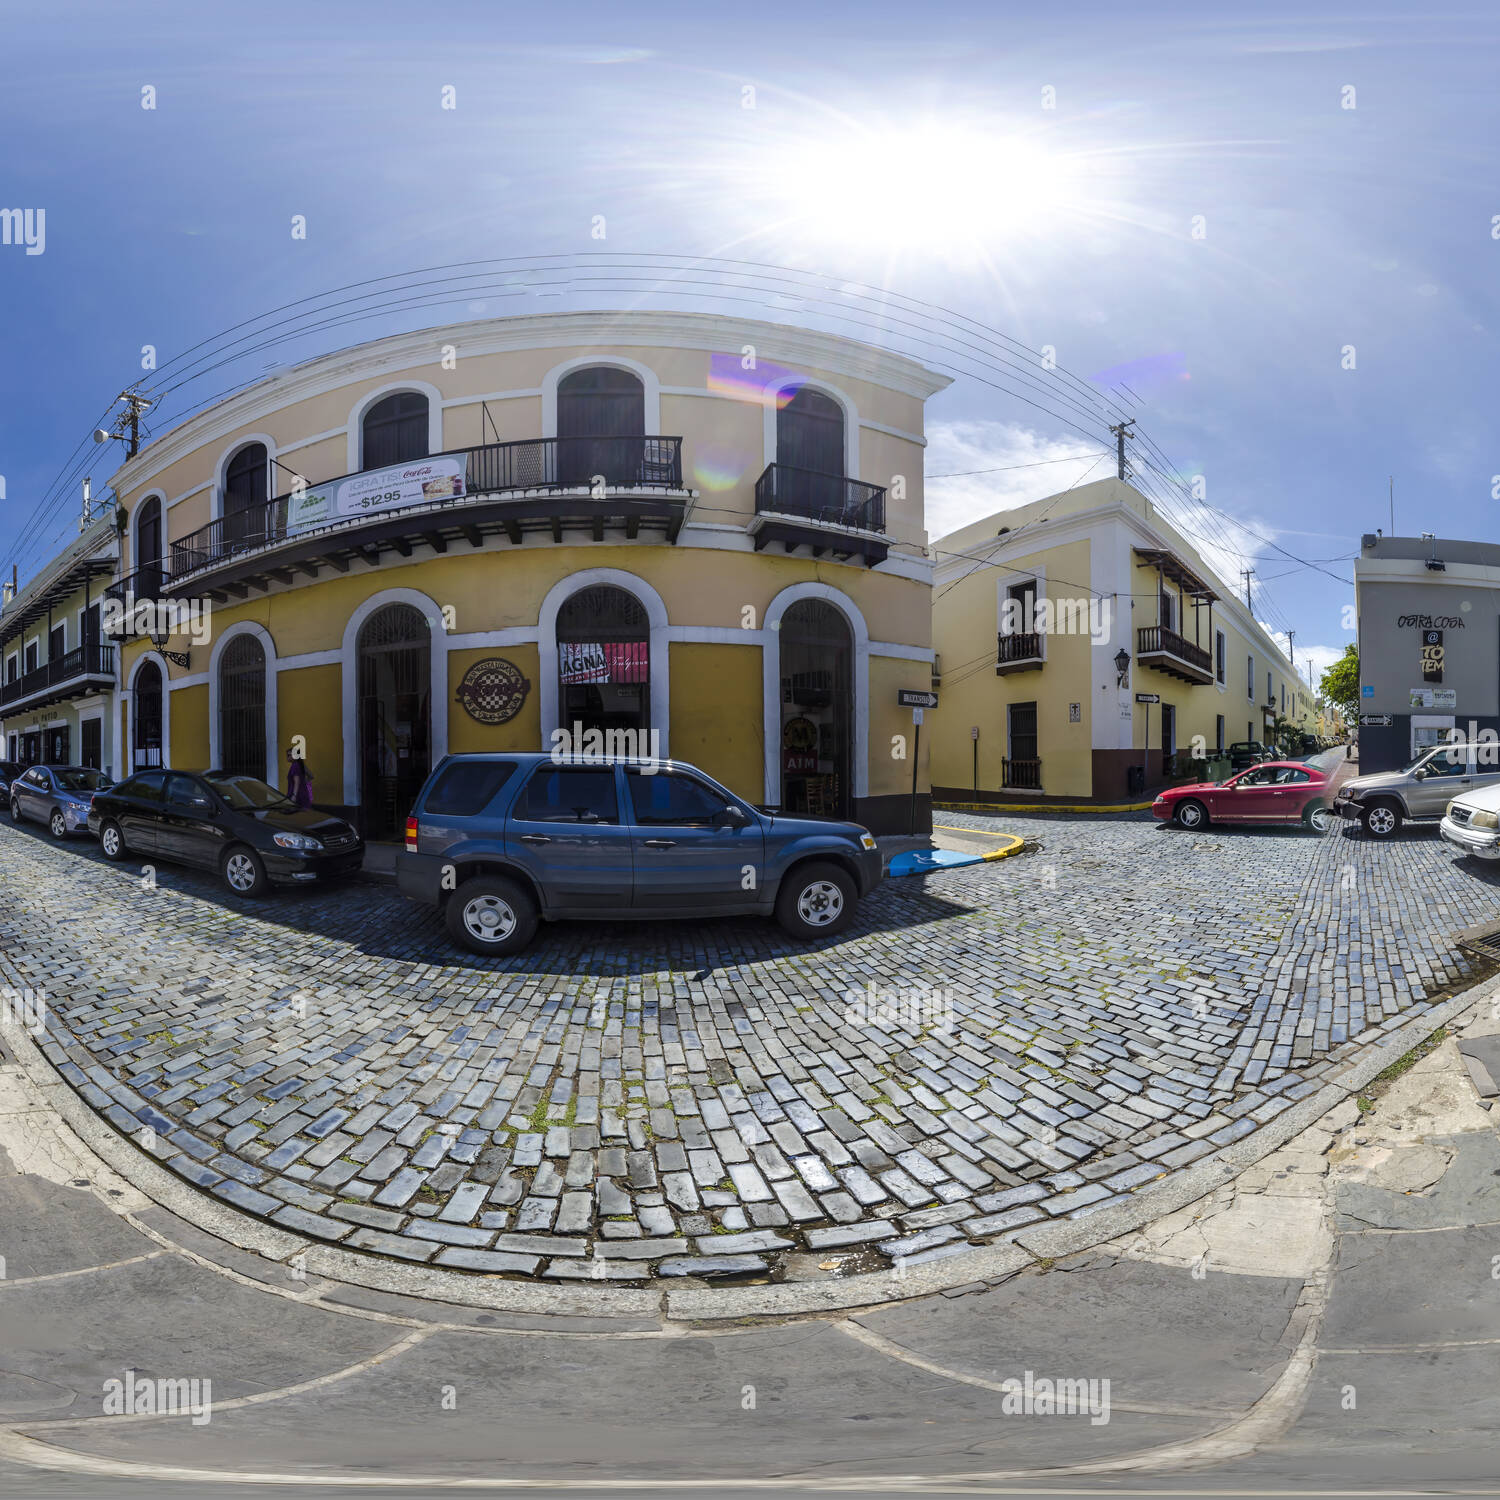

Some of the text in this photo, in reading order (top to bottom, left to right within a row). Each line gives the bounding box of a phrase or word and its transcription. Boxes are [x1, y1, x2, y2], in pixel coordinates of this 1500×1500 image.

[361, 491, 401, 509] $12.95
[1398, 615, 1465, 629] OSTRA COSA
[560, 653, 607, 675] AGNA
[1419, 659, 1445, 672] TEM
[787, 758, 815, 769] ATM
